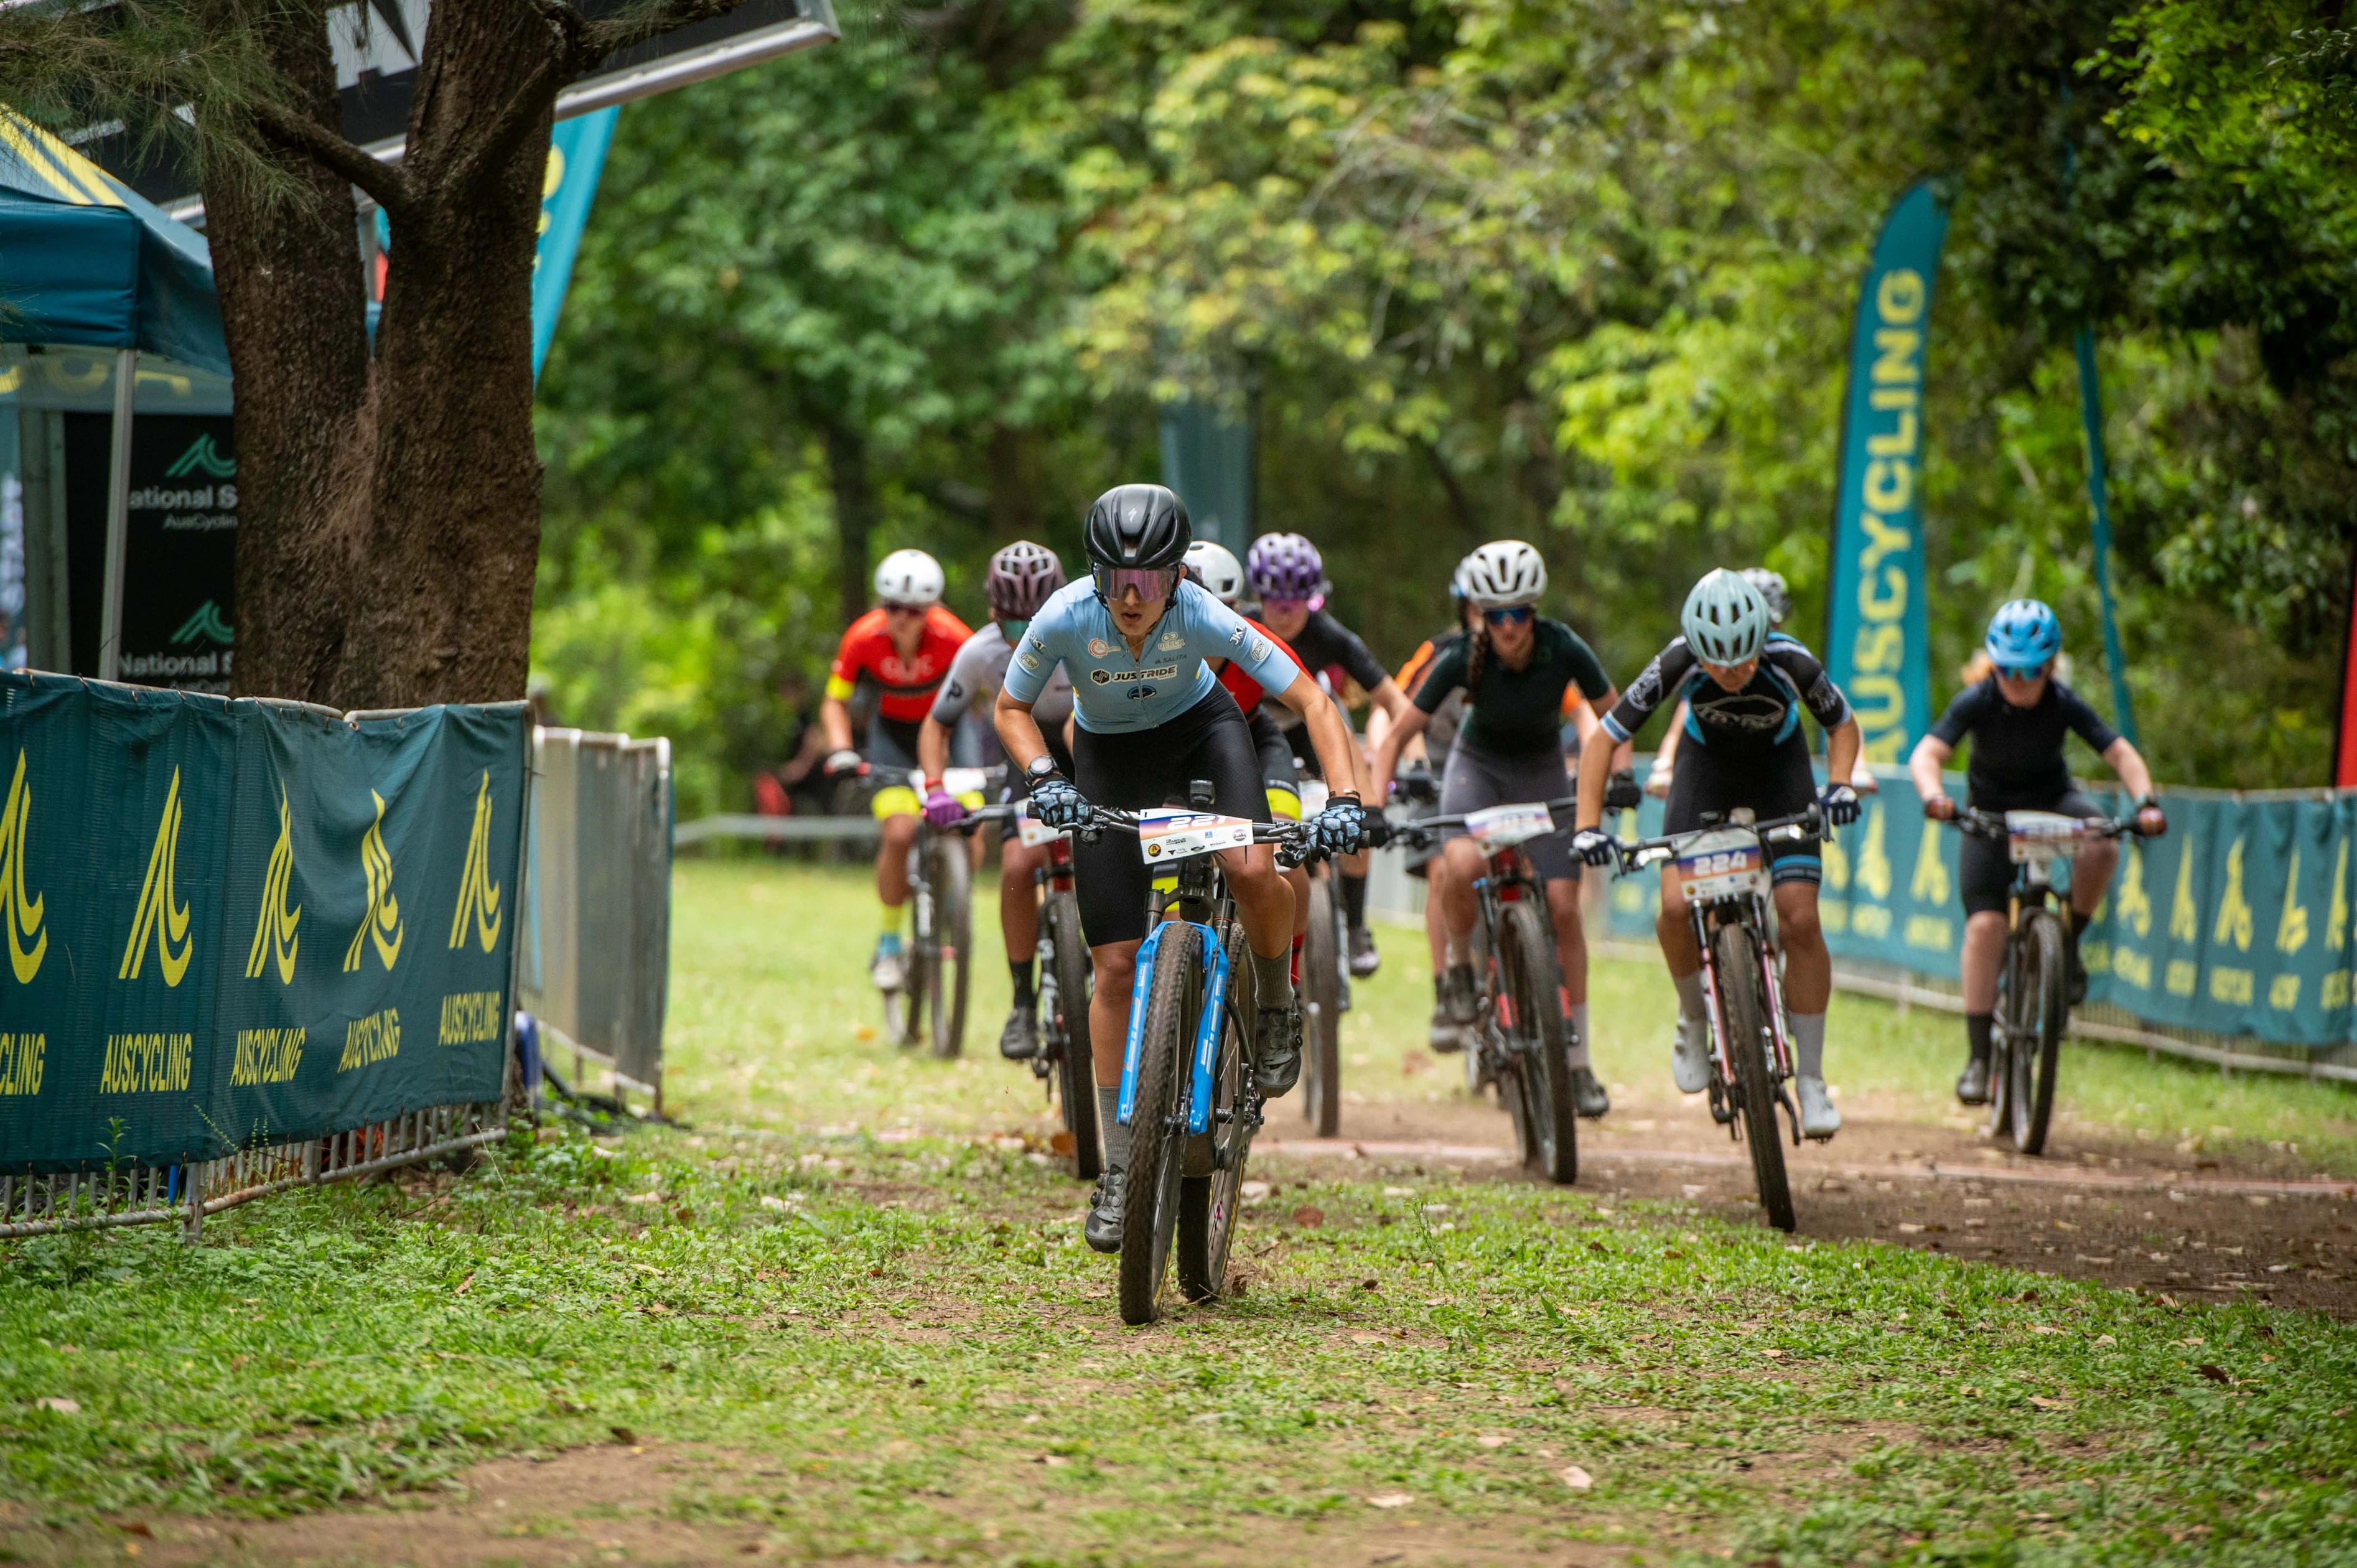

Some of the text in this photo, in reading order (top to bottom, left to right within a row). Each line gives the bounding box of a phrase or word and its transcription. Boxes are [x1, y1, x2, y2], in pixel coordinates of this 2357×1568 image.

[129, 485, 213, 511] ational
[163, 513, 239, 533] AusCyclin
[1849, 268, 1925, 775] AUSCYCLING
[1163, 654, 1188, 663] SALITA
[1113, 666, 1176, 681] JUSTRIDE
[1694, 851, 1747, 877] 224
[437, 991, 500, 1047] AUSCYCLING
[100, 1033, 192, 1094] AUSCYCLING
[230, 1027, 306, 1086] AUSCYCLING
